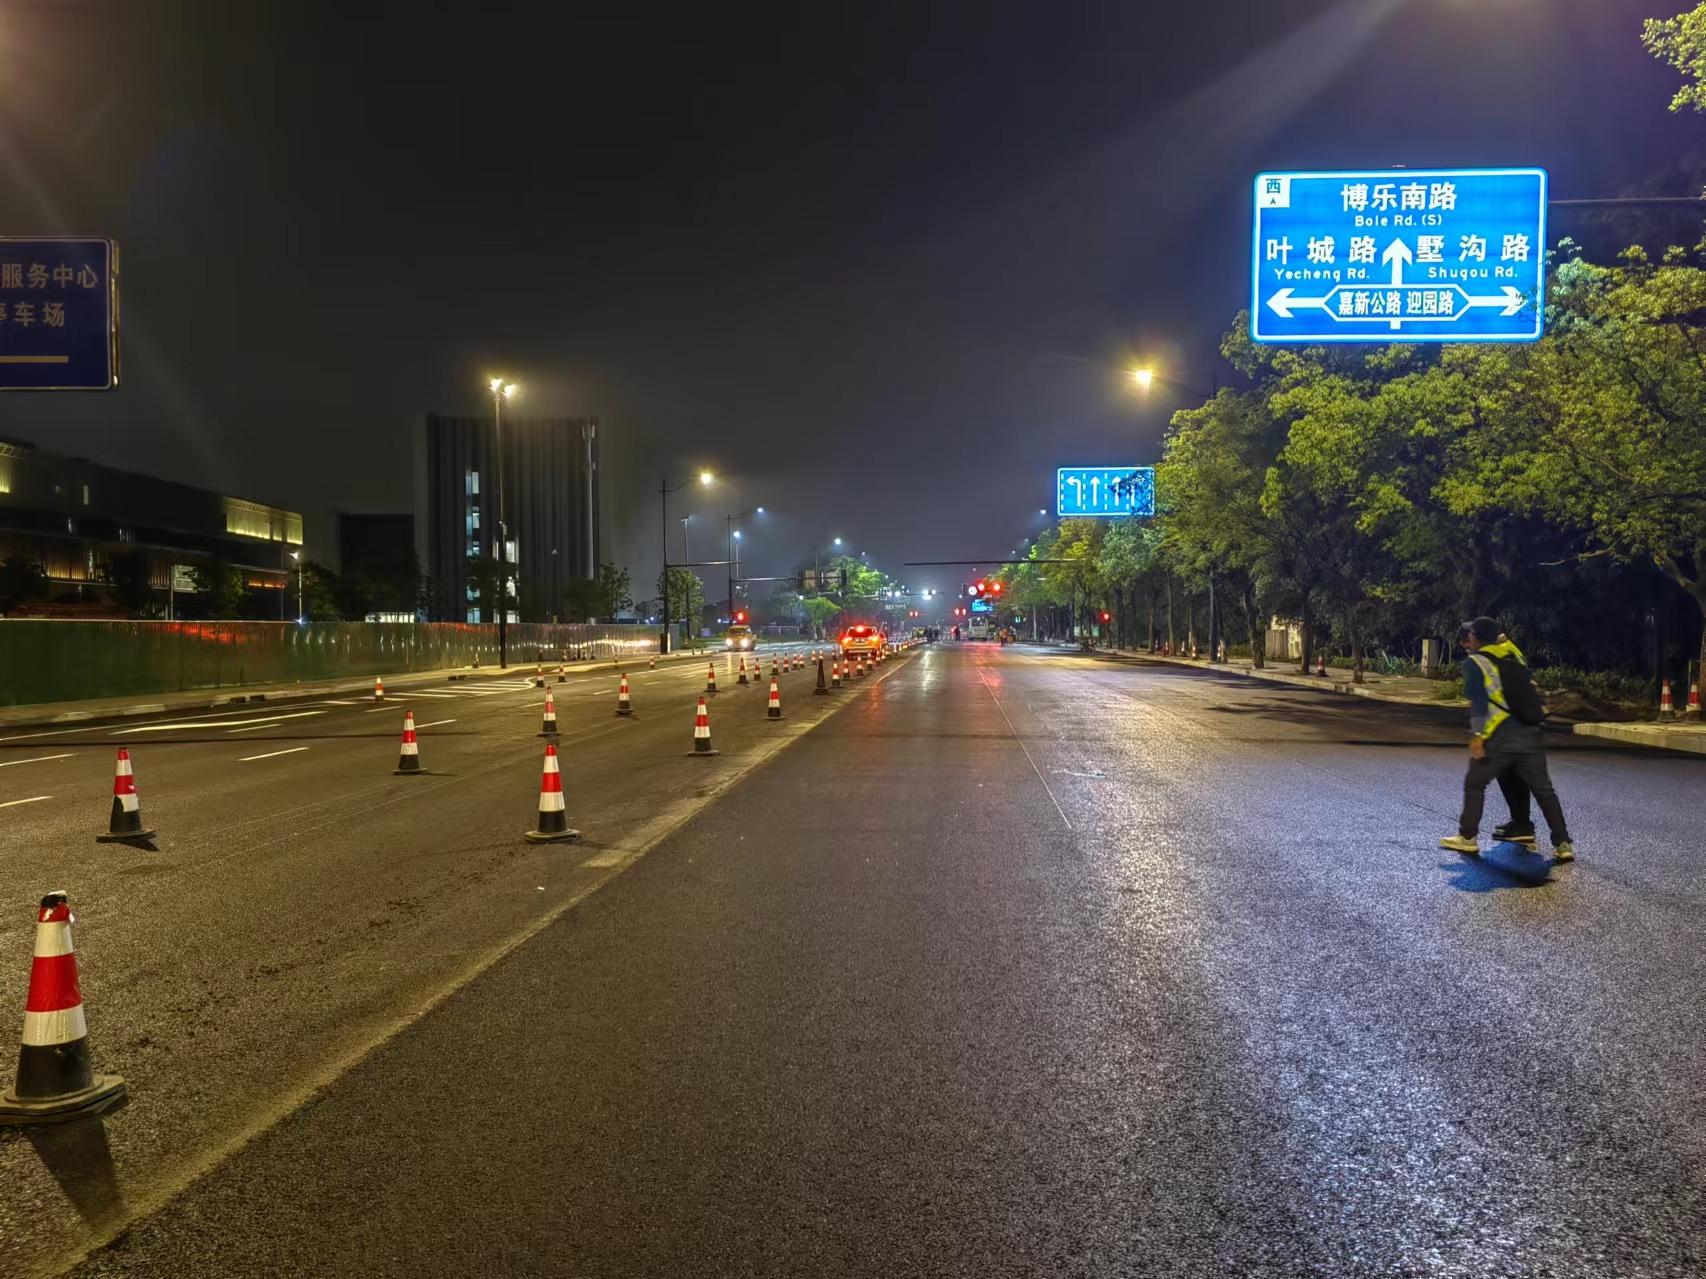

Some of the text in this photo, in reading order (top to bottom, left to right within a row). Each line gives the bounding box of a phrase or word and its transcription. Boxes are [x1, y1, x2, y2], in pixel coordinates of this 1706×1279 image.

[1266, 178, 1282, 194] 西
[1340, 181, 1457, 212] 博乐南路
[1355, 214, 1442, 227] Bole Rd. (S)
[1266, 235, 1377, 264] 叶城路
[1416, 233, 1530, 263] 墅沟路
[1, 262, 98, 289] 服务中心
[1274, 268, 1370, 282] Yecheng Rd.
[1427, 266, 1518, 281] Shugou Rd.
[1338, 290, 1455, 315] 嘉新公路 迎园路
